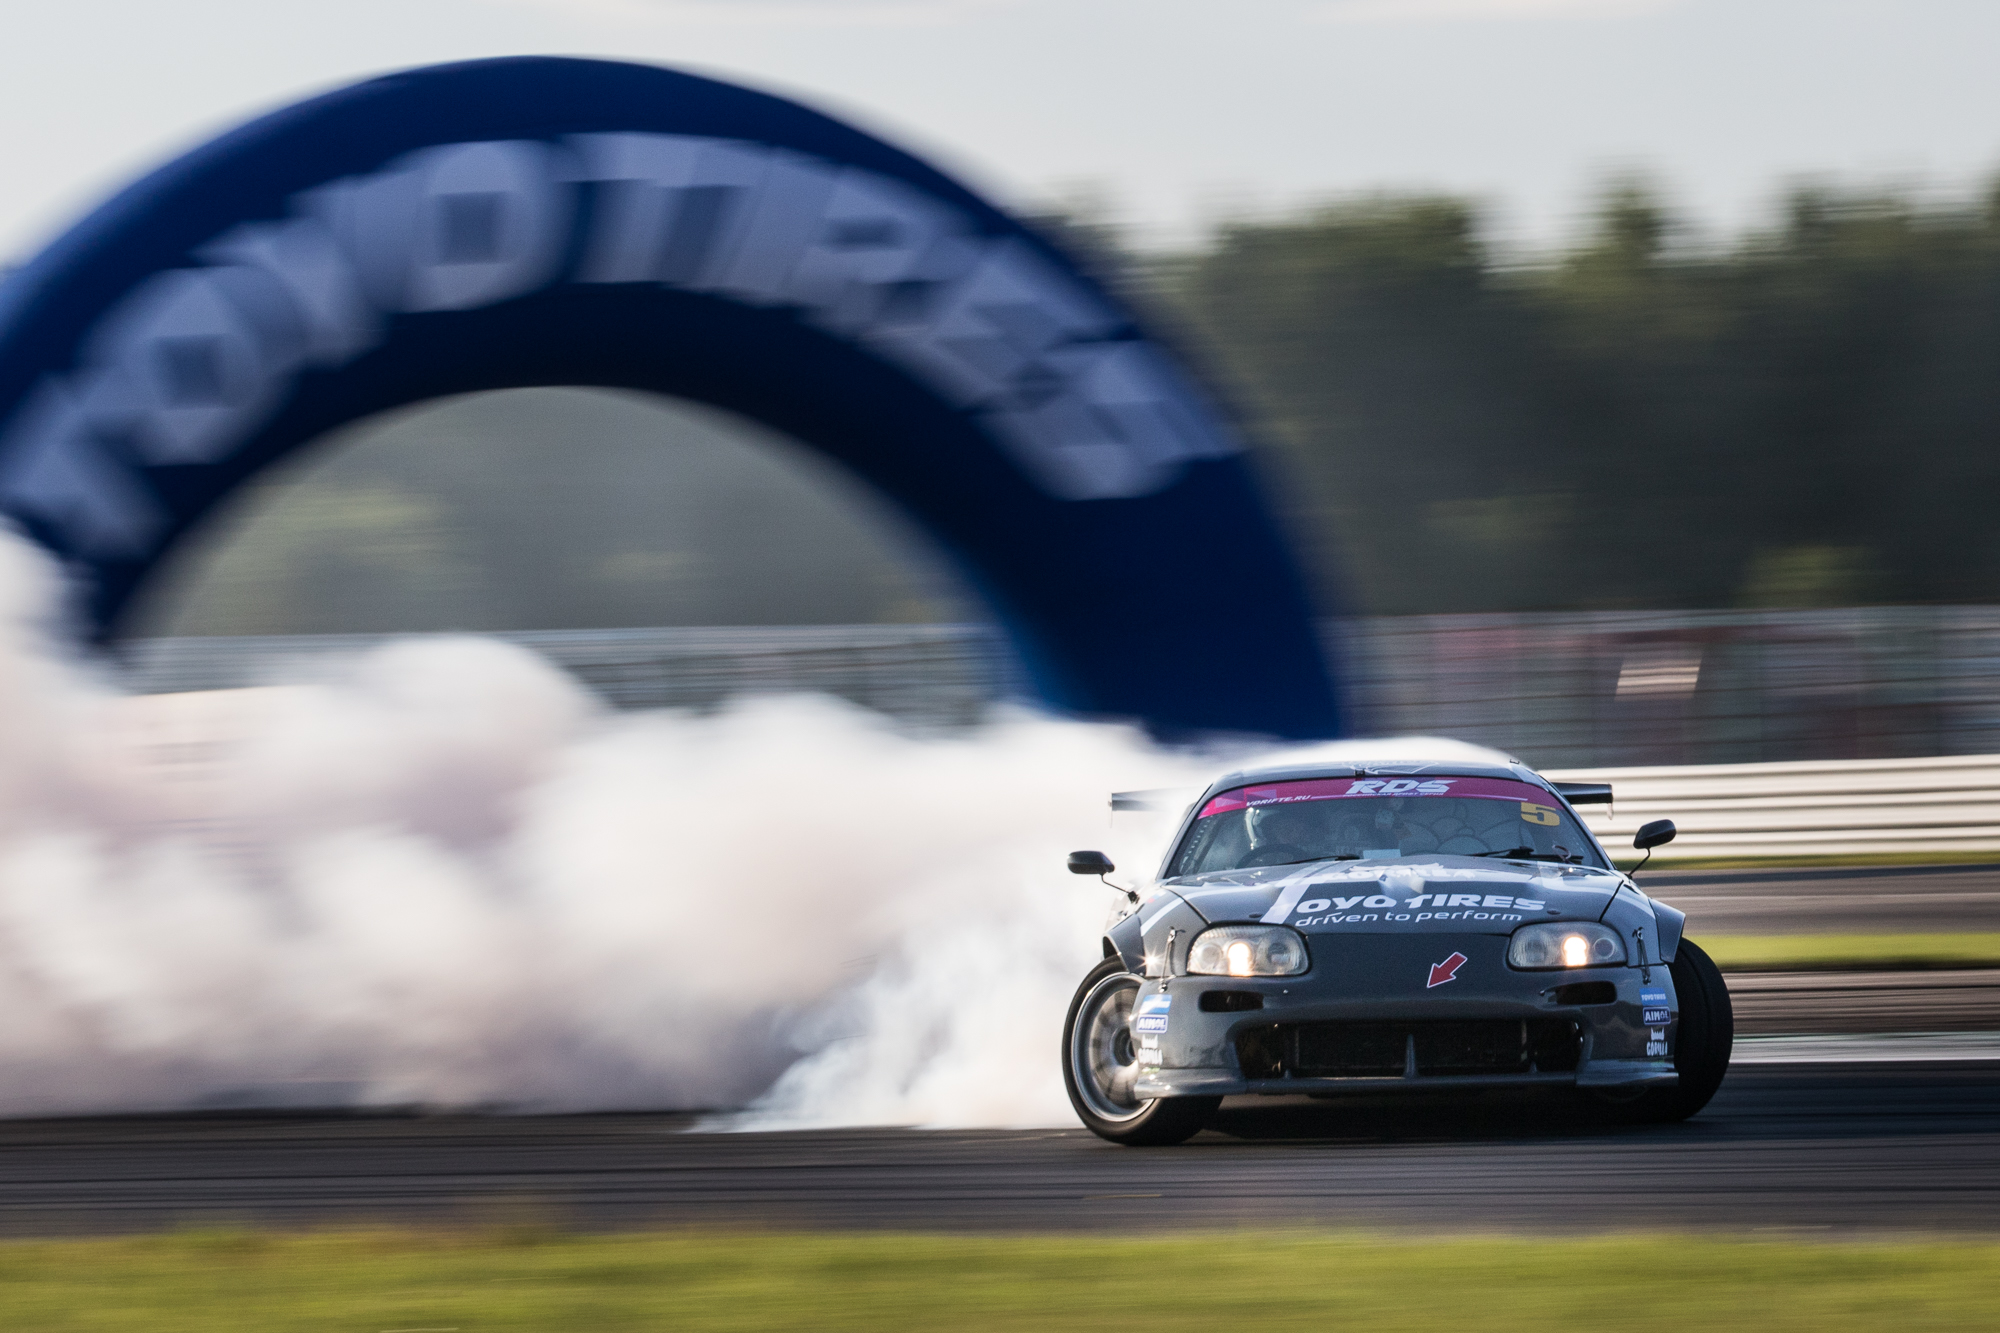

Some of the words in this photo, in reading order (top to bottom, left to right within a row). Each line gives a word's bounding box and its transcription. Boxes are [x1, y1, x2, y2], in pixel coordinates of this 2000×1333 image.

[1345, 779, 1458, 795] RDS
[1246, 794, 1312, 807] VDRIFTE.RU
[1521, 802, 1560, 826] 5
[1404, 893, 1546, 911] TIRES
[1295, 911, 1379, 927] driven
[1384, 912, 1411, 921] to
[1415, 910, 1523, 923] perform
